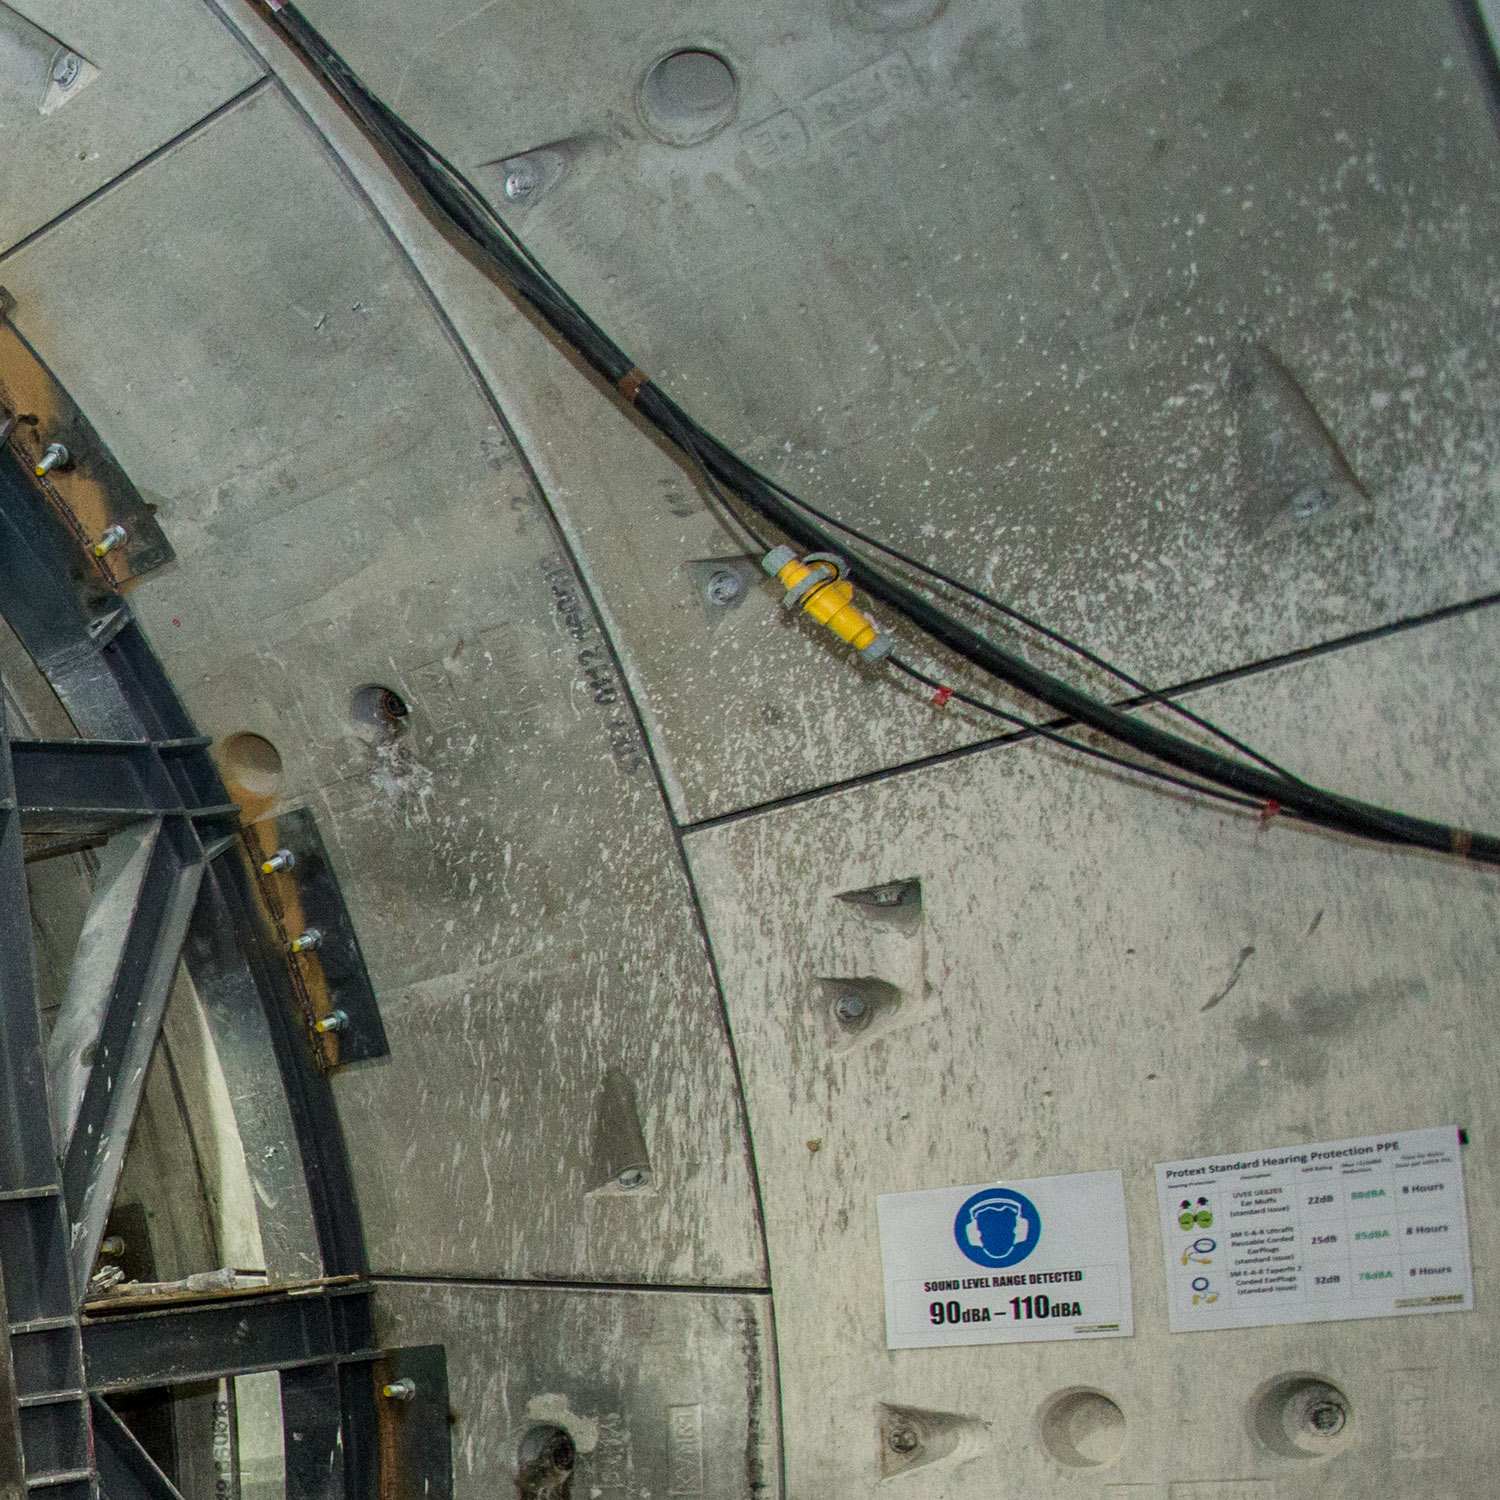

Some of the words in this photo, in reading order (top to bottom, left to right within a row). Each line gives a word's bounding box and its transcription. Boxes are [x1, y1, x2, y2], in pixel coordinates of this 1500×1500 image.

[1165, 1159, 1206, 1178] Protext
[1208, 1157, 1260, 1174] Standard
[1262, 1152, 1308, 1169] Hearing
[1310, 1145, 1373, 1162] Protection
[1376, 1141, 1400, 1153] PPE
[1412, 1183, 1445, 1193] Hours
[1307, 1194, 1334, 1205] 22dB
[1415, 1224, 1449, 1234] Hours
[1310, 1235, 1338, 1245] 25dB
[1419, 1265, 1452, 1275] Hours
[924, 1279, 960, 1292] SOUND
[962, 1277, 991, 1290] LEVEL
[993, 1274, 1027, 1287] RANGE
[1029, 1270, 1083, 1285] DETECTED
[1314, 1274, 1341, 1285] 32dB
[929, 1300, 991, 1325] 90dBA
[1009, 1294, 1082, 1320] 110dBA
